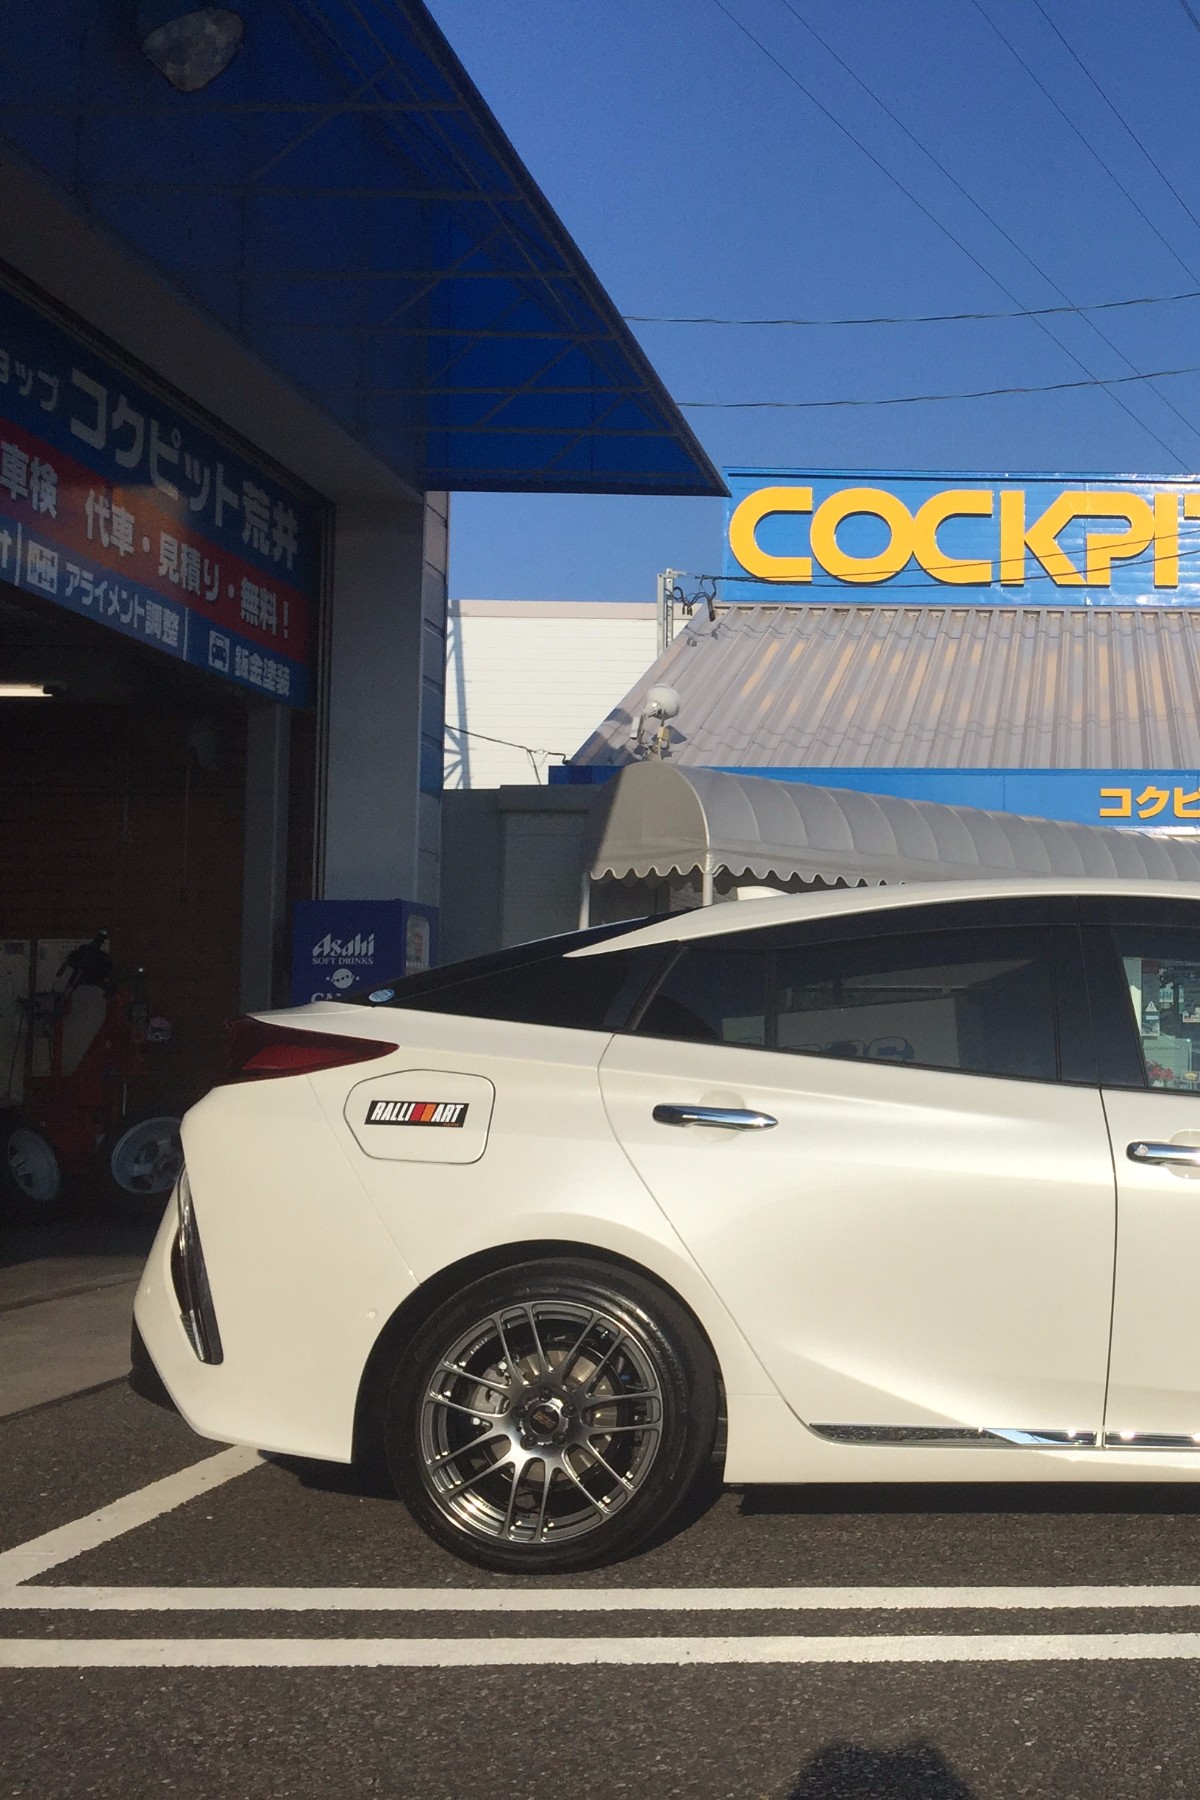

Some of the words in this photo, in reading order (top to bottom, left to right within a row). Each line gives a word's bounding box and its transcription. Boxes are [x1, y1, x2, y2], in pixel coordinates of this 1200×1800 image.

[0, 440, 58, 518] 車検
[70, 367, 299, 570] コクピット荒井
[312, 933, 375, 957] Asahi
[312, 957, 337, 965] SOFT
[339, 957, 374, 965] DRINKS
[370, 1102, 416, 1122] RALLI
[430, 1103, 464, 1123] ART
